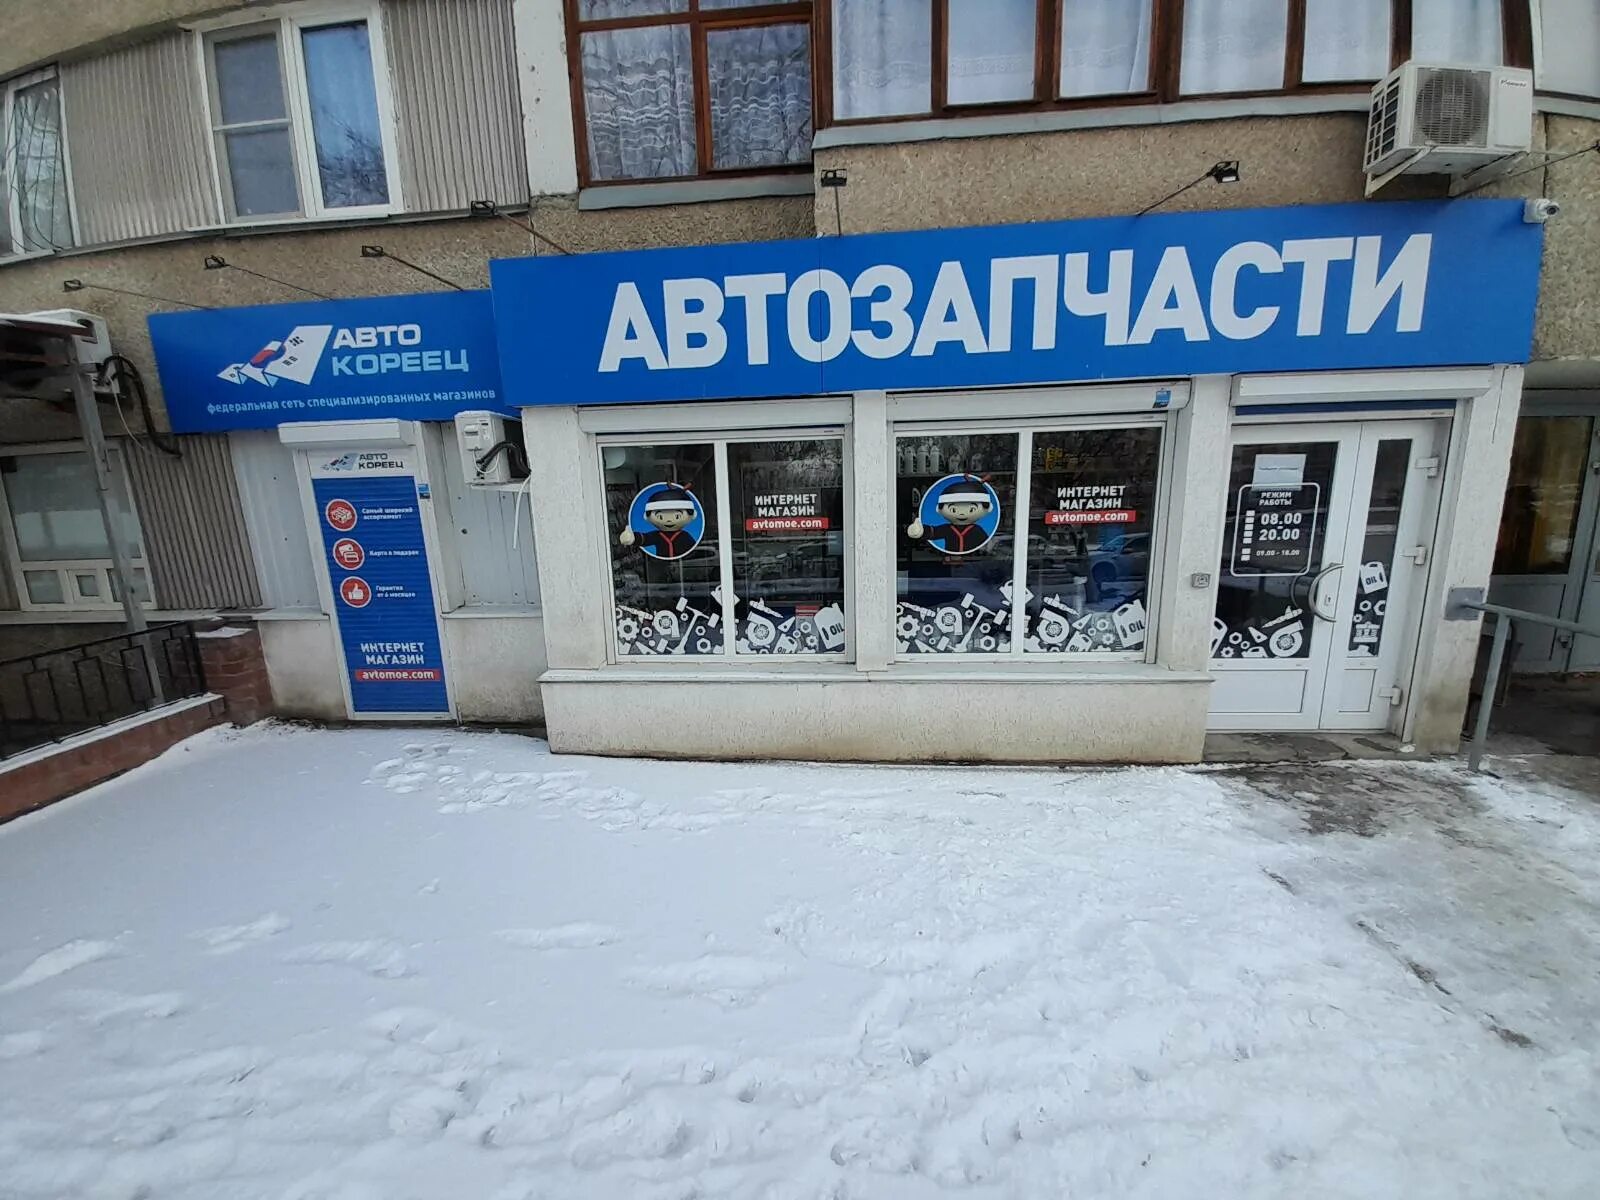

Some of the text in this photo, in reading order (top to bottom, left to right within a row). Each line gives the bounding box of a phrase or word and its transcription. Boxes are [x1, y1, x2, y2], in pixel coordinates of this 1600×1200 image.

[598, 233, 1432, 373] АВТОЗАПЧАСТИ
[332, 324, 421, 349] АВТО
[332, 349, 469, 376] КОРЕЕЦ
[207, 389, 496, 415] федеральная сеть специализированных магазинов
[358, 453, 388, 461] АВТО
[358, 461, 404, 470] КОРЕЕЦ
[1057, 485, 1126, 498] ИНТЕРНЕТ
[1261, 491, 1292, 499] РЕЖИМ
[754, 494, 817, 506] ИНТЕРНЕТ
[1059, 498, 1122, 510] МАГАЗИН
[758, 505, 815, 518] МАГАЗИН
[1051, 511, 1128, 523] avtomoe.com
[752, 518, 822, 529] avtomoe.com
[1260, 512, 1302, 525] 08.00
[1258, 528, 1300, 541] 20.00
[829, 622, 845, 636] OIL
[1128, 619, 1145, 633] OIL
[360, 642, 425, 653] ИНТЕРНЕТ
[365, 654, 424, 665] МАГАЗИН
[362, 670, 434, 680] avtomoe.com
